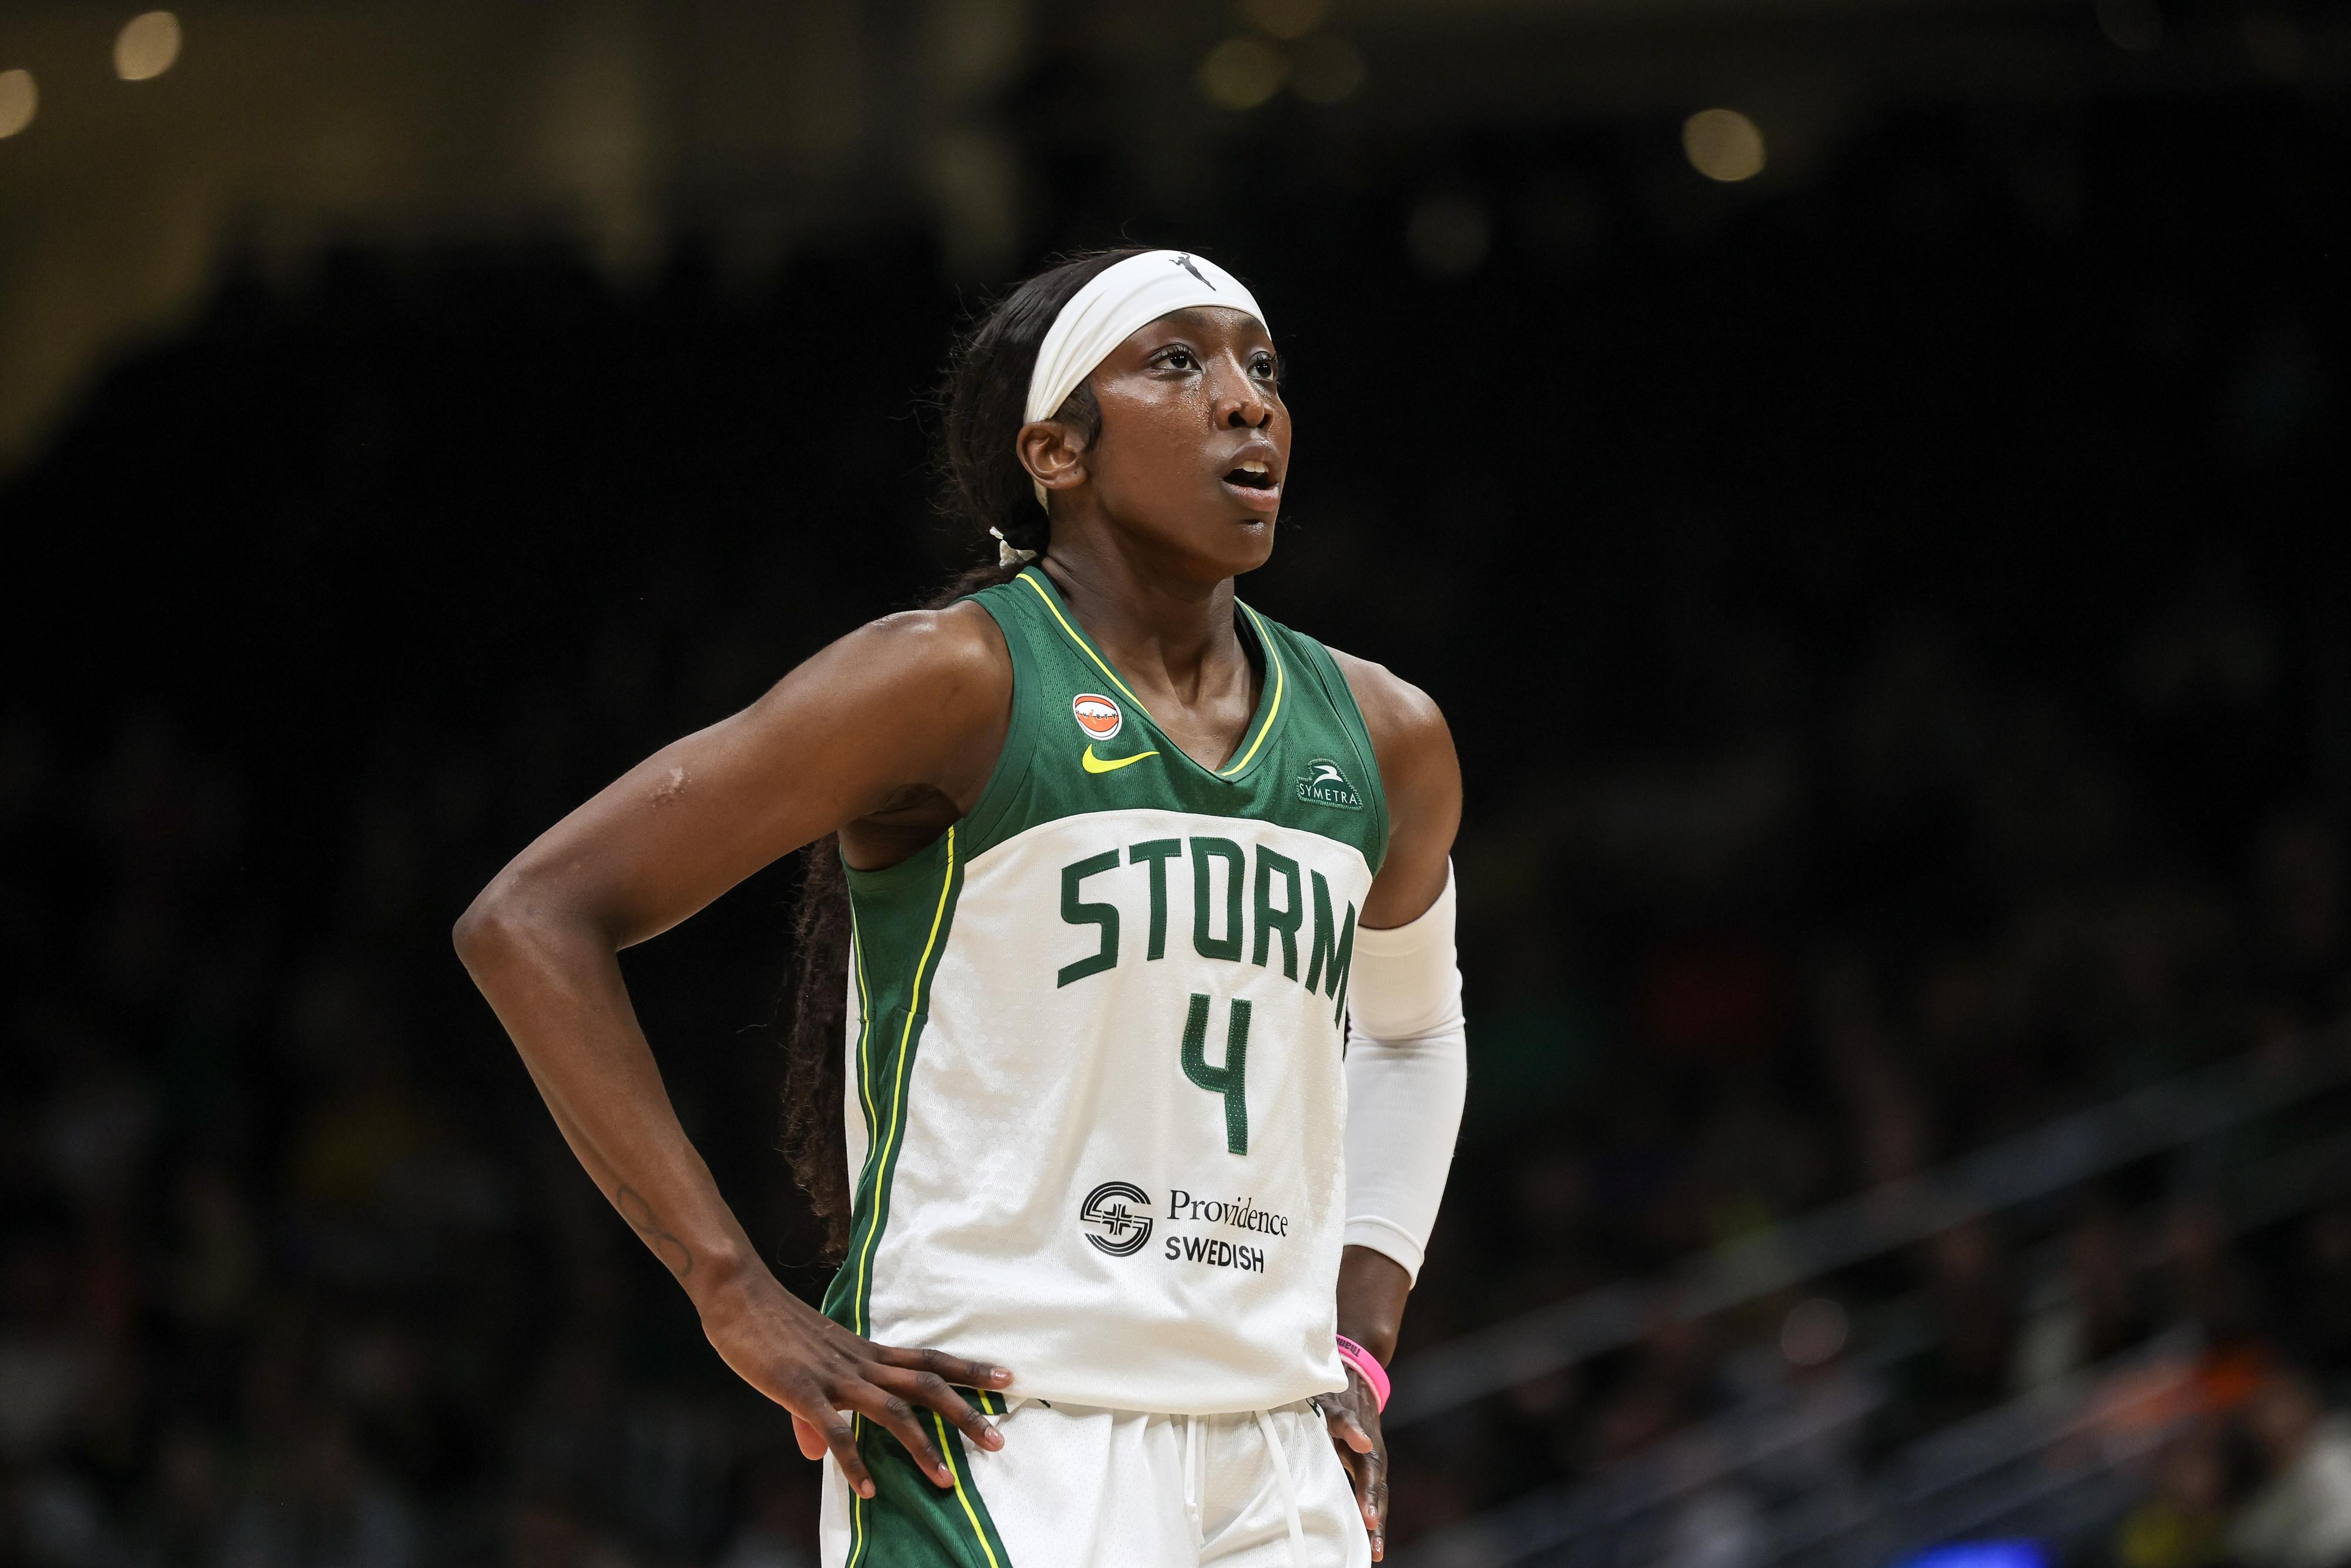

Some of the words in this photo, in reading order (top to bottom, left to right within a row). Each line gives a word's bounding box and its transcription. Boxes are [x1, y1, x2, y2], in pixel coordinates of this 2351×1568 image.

[1299, 783, 1358, 805] SYMETRA
[1057, 836, 1356, 1030] STORM
[1181, 992, 1252, 1156] 4
[1166, 1189, 1288, 1237] Providence
[1165, 1236, 1264, 1274] SWEDISH
